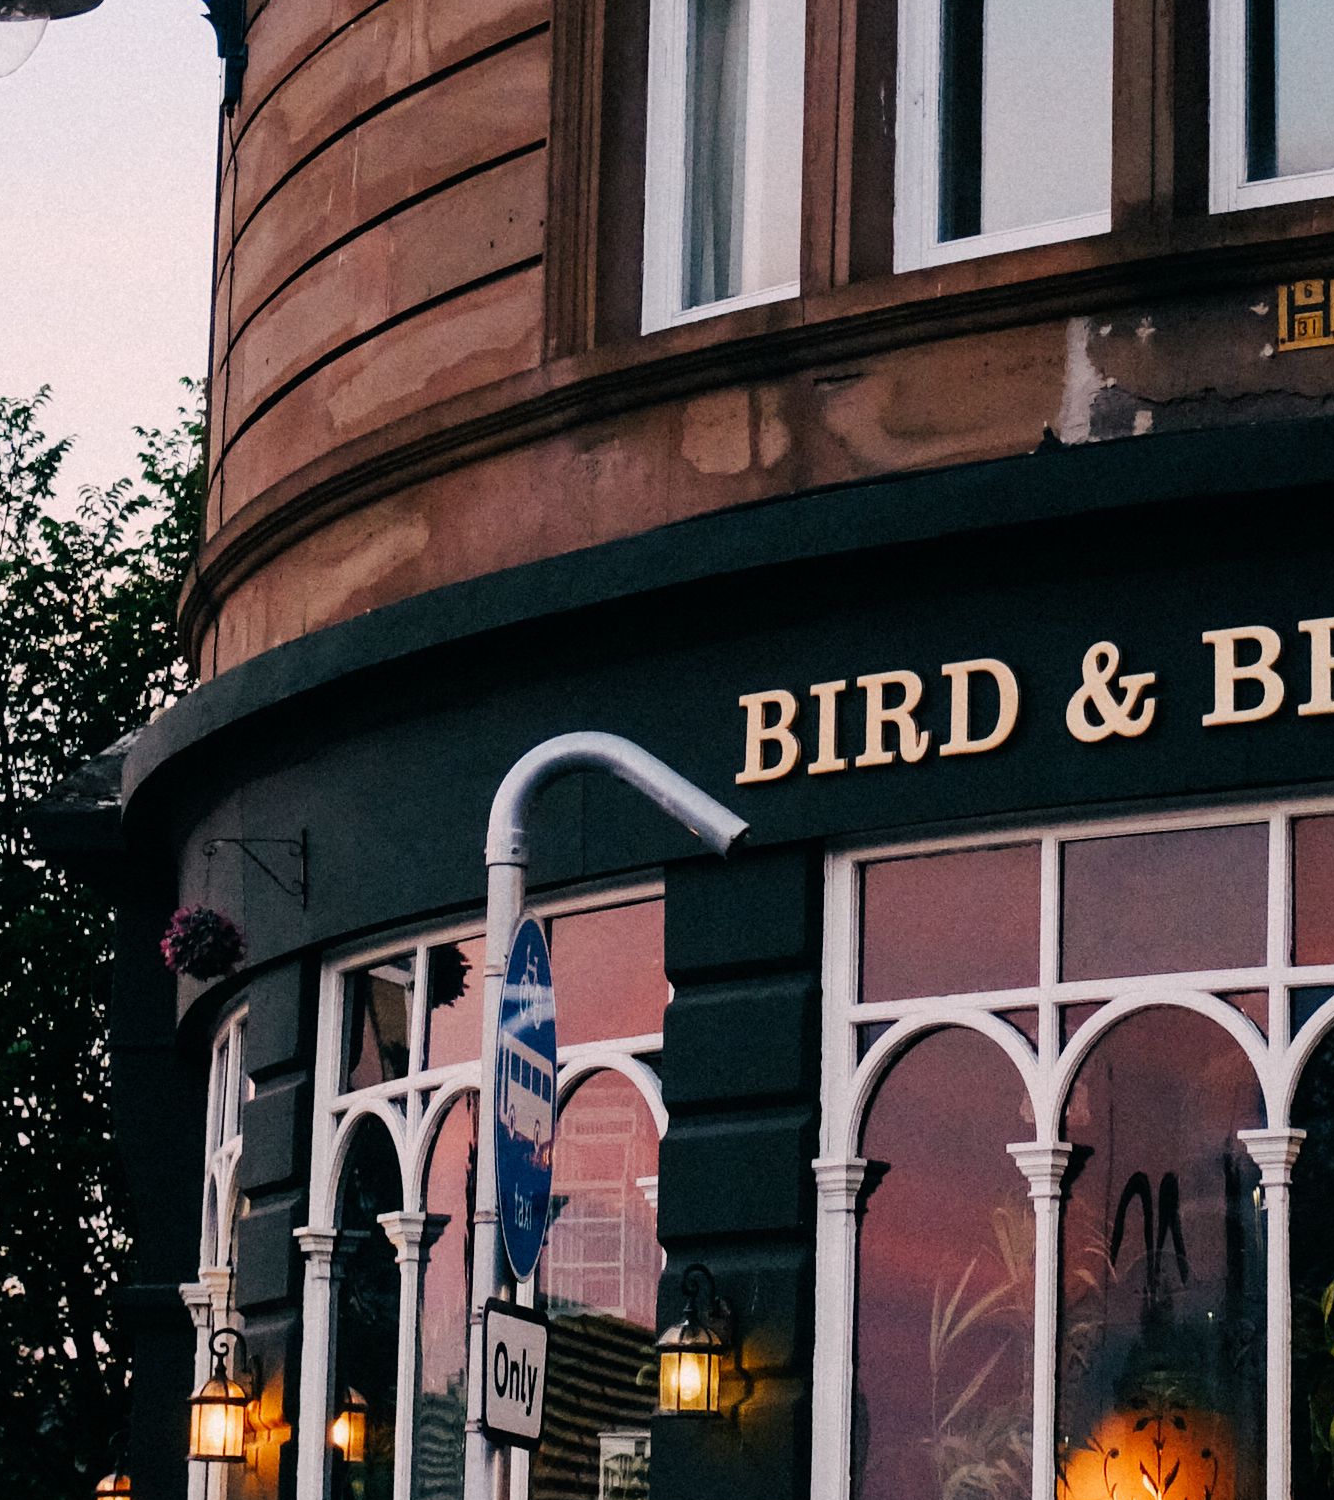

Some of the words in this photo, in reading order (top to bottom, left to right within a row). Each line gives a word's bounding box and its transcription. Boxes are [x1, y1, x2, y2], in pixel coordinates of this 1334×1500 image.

[1303, 283, 1313, 299] 6
[735, 658, 1020, 785] BIRD
[1066, 641, 1156, 743] &
[514, 1182, 534, 1231] taxi
[494, 1341, 537, 1417] Only
